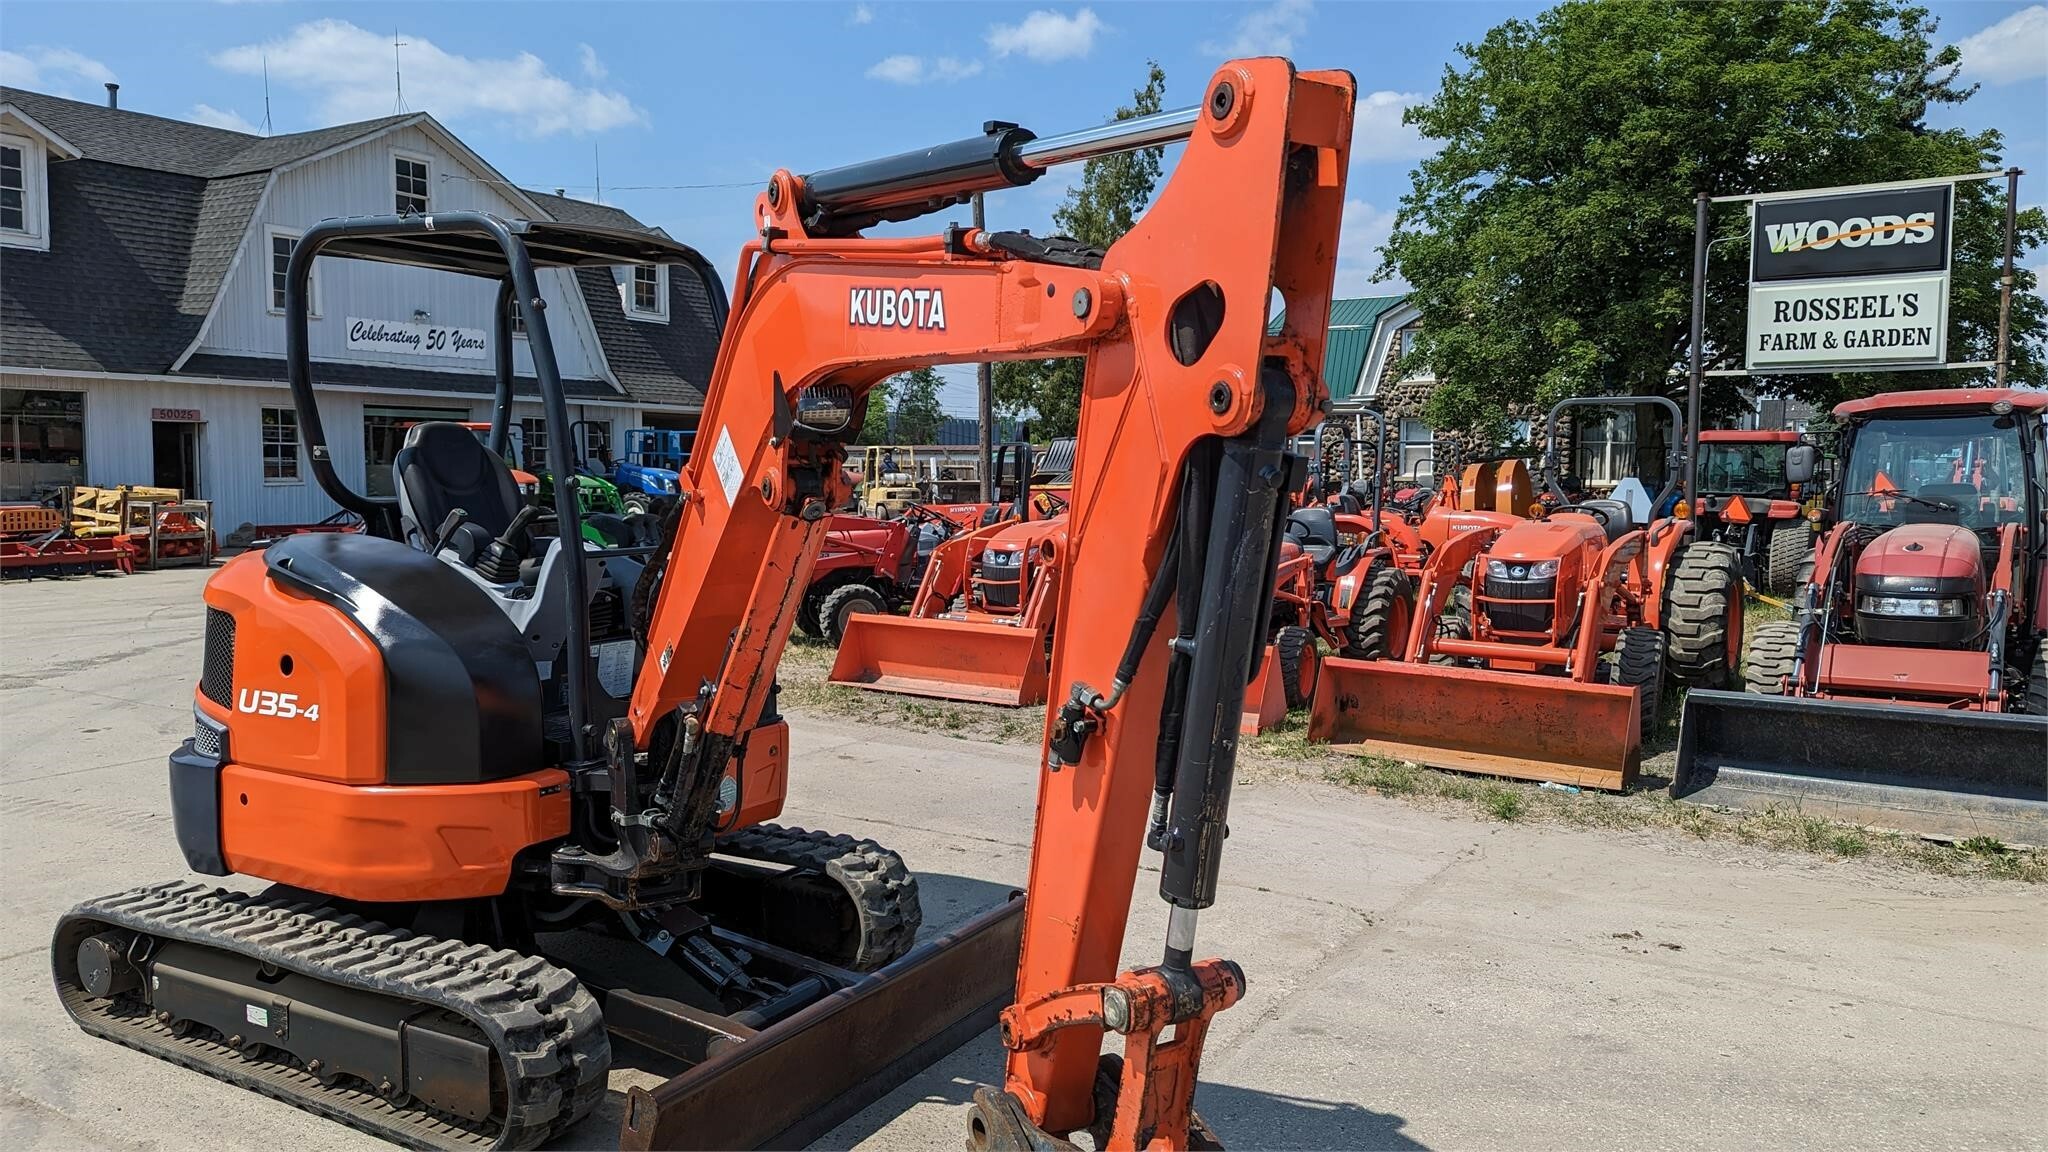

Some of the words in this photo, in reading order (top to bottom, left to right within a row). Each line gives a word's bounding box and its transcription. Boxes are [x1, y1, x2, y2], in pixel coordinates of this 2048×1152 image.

[1765, 212, 1935, 254] WOODS
[849, 287, 946, 330] KUBOTA
[1773, 293, 1919, 323] ROSSEEL'S
[350, 320, 421, 351] Celebrating
[426, 329, 447, 351] 50
[451, 329, 486, 352] Years
[1759, 331, 1817, 351] FARM
[1822, 330, 1838, 349] &
[1843, 327, 1932, 349] GARDEN
[160, 409, 193, 419] 50025
[238, 688, 319, 722] U35-4
